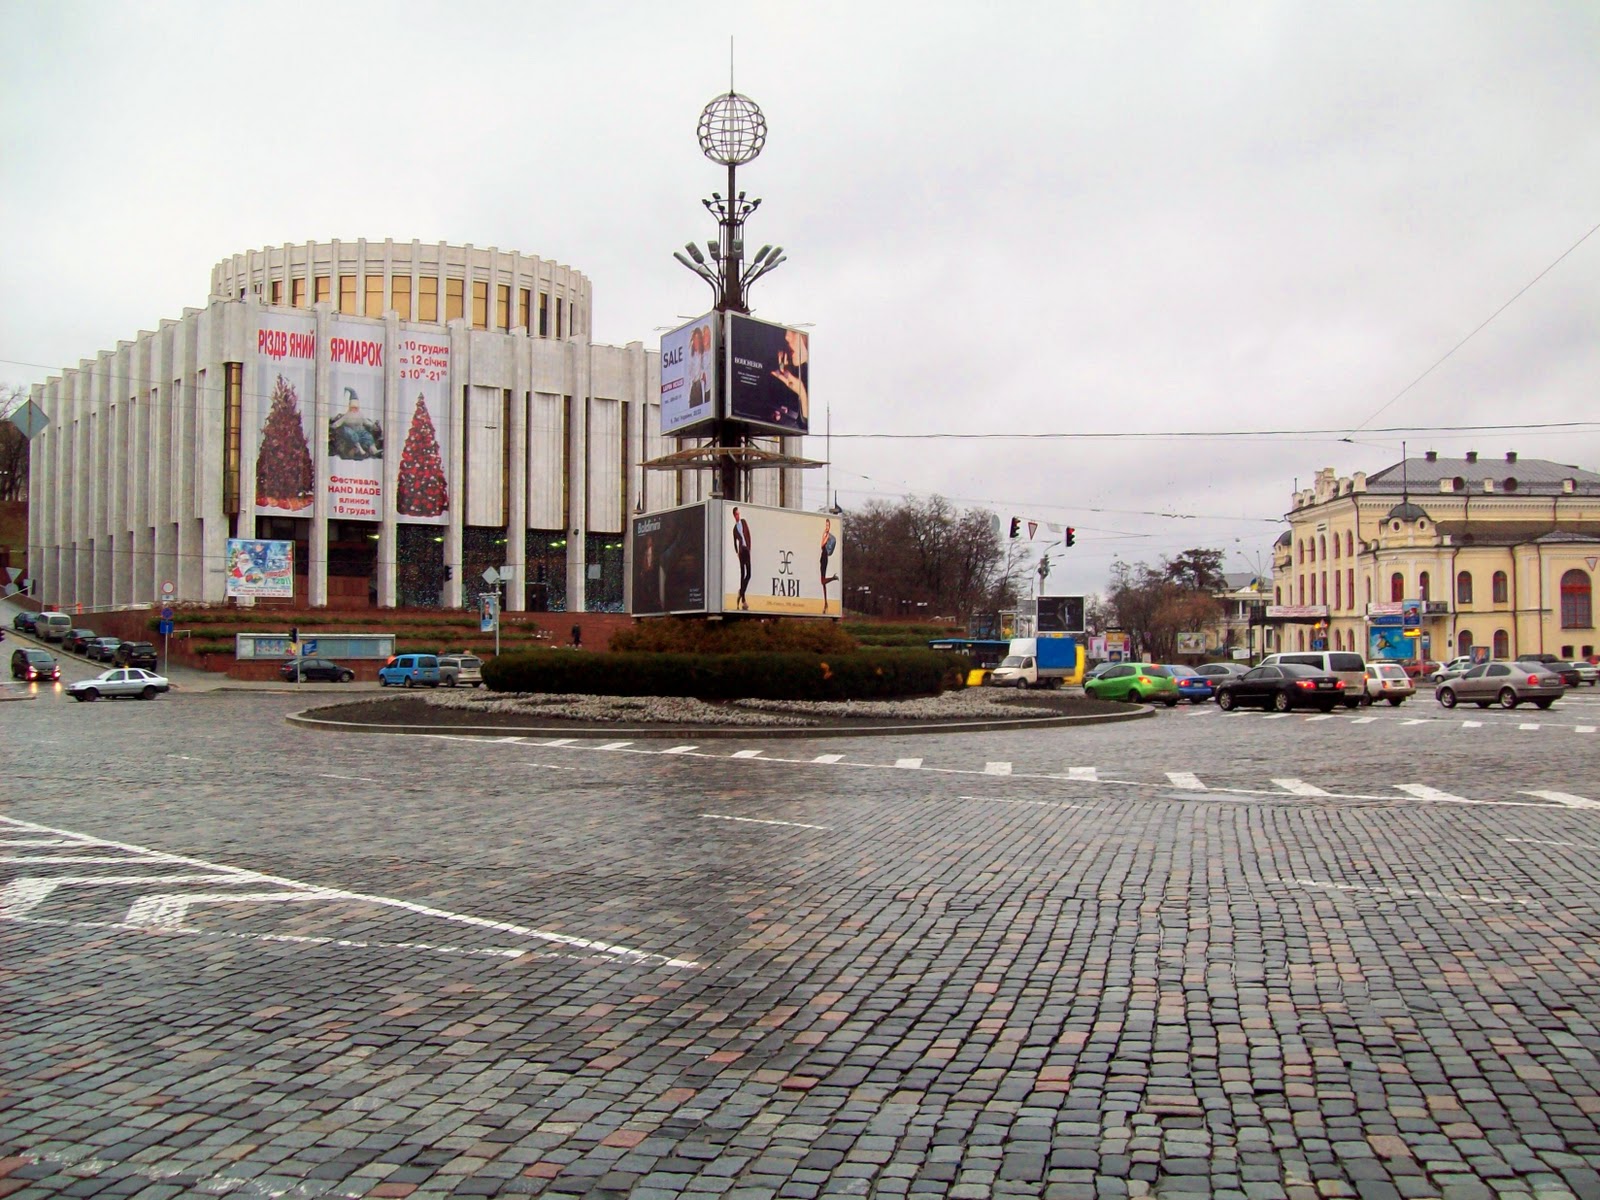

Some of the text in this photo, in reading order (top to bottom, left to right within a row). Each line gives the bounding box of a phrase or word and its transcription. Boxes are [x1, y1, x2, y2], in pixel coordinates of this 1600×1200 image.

[330, 337, 383, 367] ЯРМАРОК
[405, 341, 416, 351] 10
[418, 344, 449, 355] грудня
[411, 355, 422, 365] 12
[423, 356, 448, 368] січня
[663, 346, 684, 369] SALE
[330, 475, 379, 486] Фестиваль
[328, 485, 381, 496] HAND MADE
[339, 497, 370, 505] ялинок
[333, 505, 376, 516] 18 грудня
[771, 577, 801, 598] FABI
